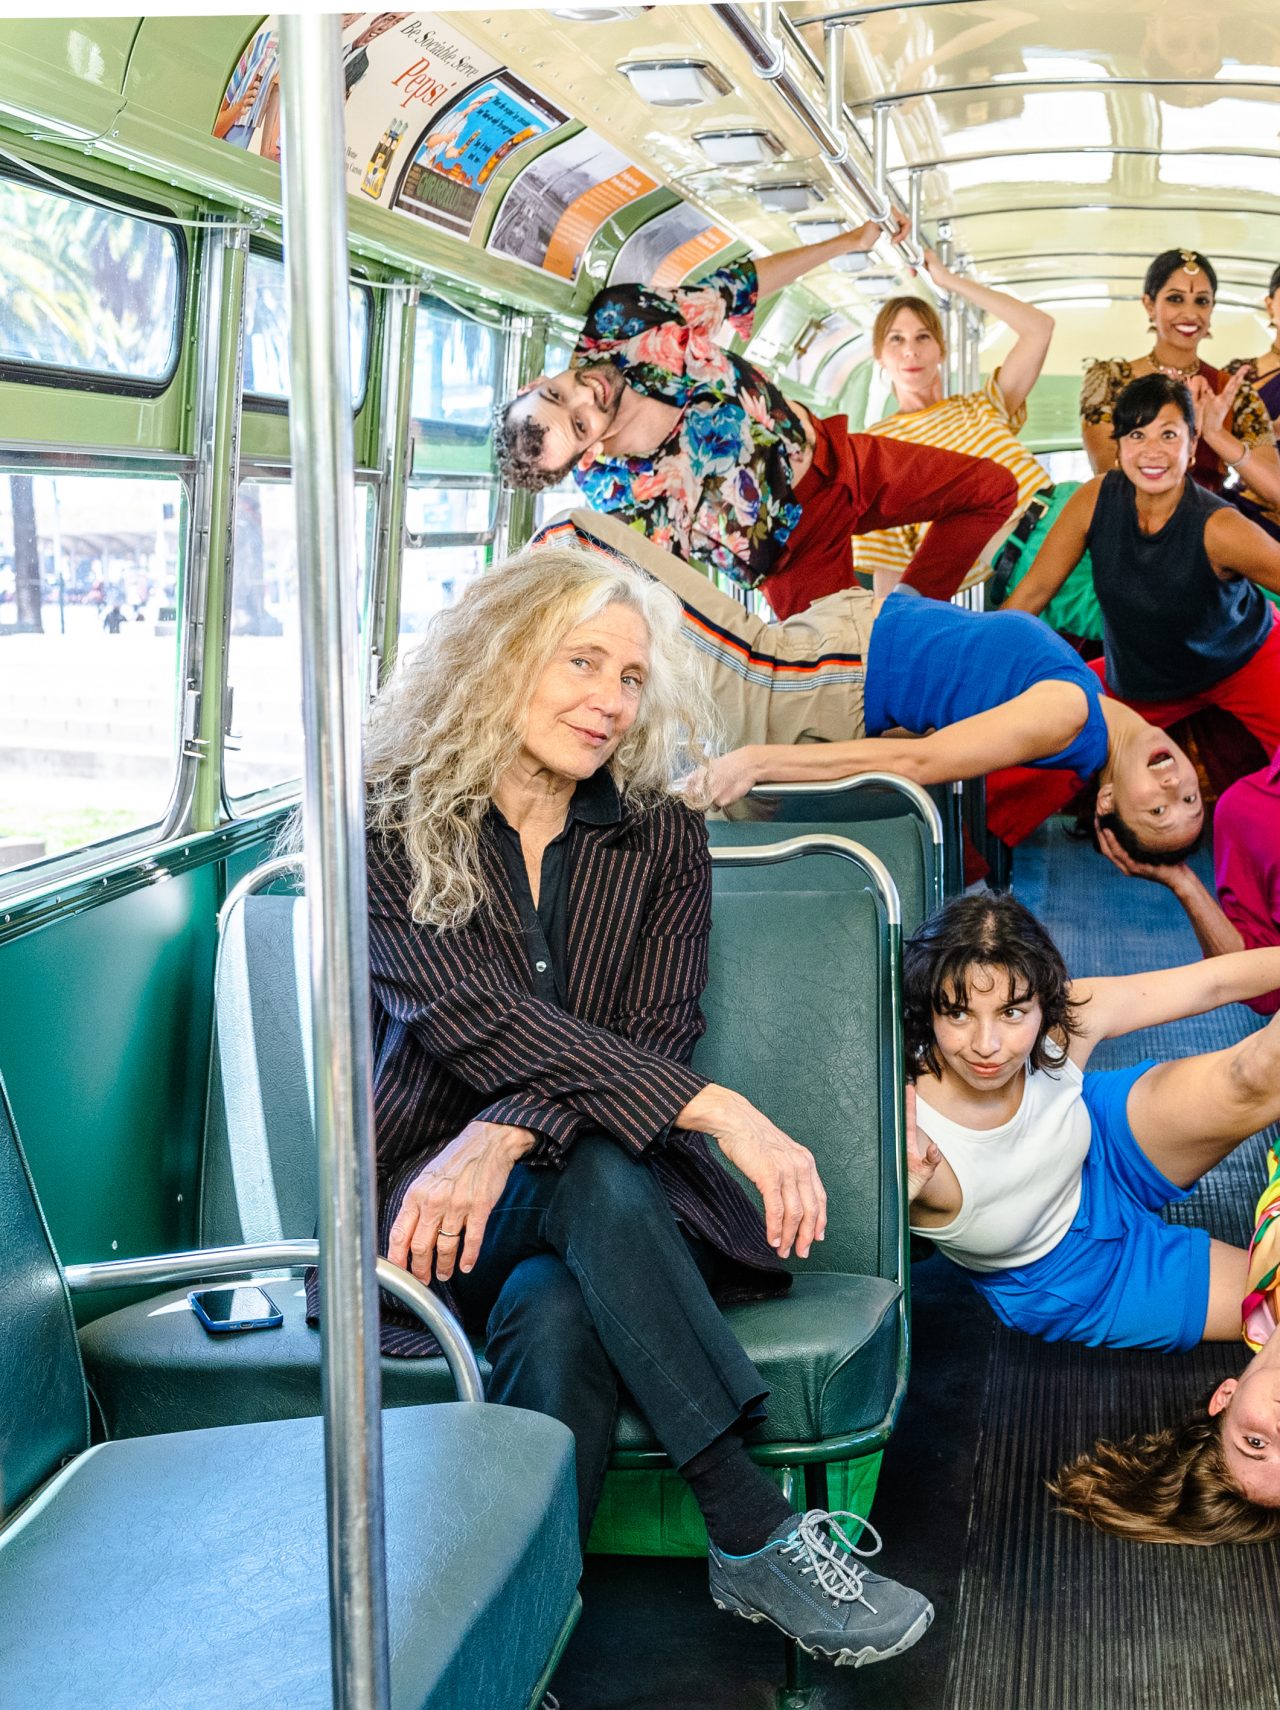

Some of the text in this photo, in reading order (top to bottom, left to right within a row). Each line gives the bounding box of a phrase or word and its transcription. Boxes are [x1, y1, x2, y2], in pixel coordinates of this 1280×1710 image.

[400, 20, 479, 78] Be Sociable, Serve
[390, 57, 457, 108] Pepsi
